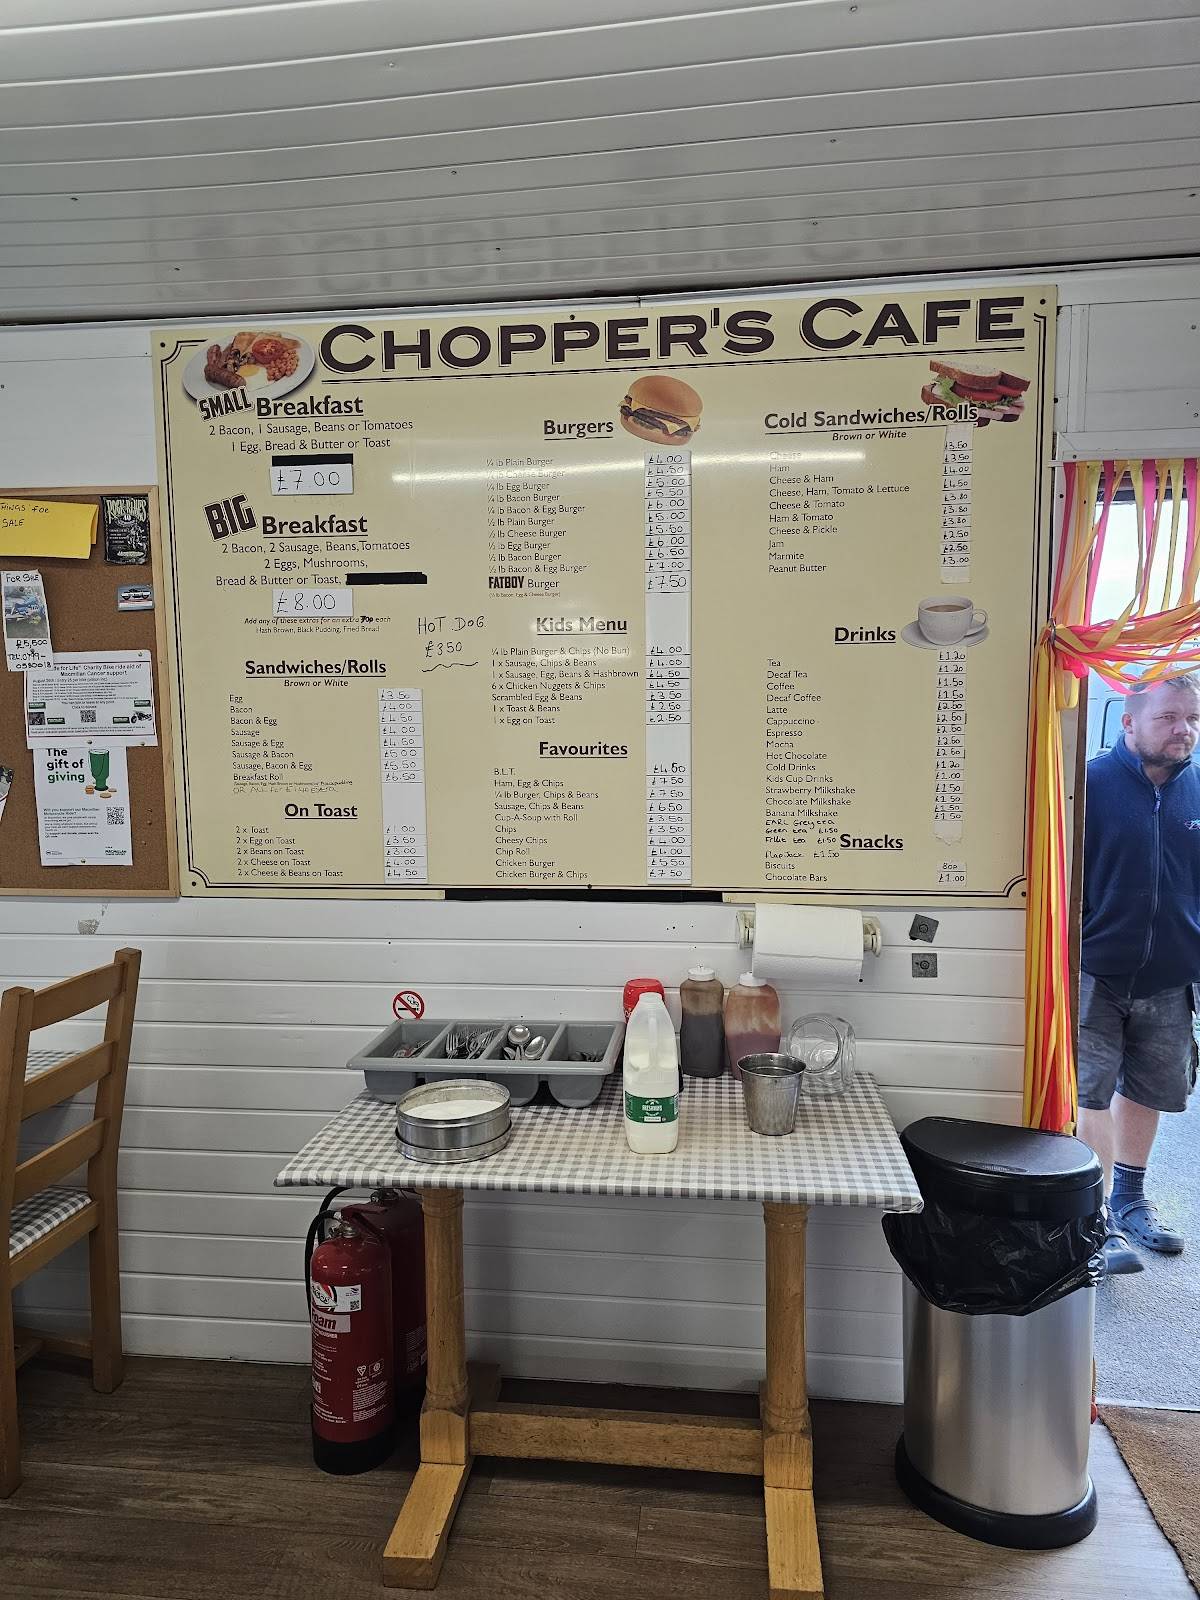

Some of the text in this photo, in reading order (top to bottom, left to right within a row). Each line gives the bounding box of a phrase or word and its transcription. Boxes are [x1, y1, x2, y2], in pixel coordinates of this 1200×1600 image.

[319, 296, 1024, 374] CHOPPER'S CAFE
[200, 388, 364, 420] SMALL Breakfast
[764, 404, 978, 430] Cold Sandwiches/Rolls
[209, 419, 413, 436] 2 Bacon, 1 Sausage, Beans or Tomatoes
[544, 420, 614, 438] Burgers
[832, 430, 907, 442] Brown or White
[232, 436, 390, 455] 1 Egg, Bread & Butter or Toast
[769, 463, 790, 472] Ham
[769, 474, 834, 484] Cheese & Ham
[204, 494, 368, 540] BIG Breakfast
[2, 518, 24, 528] SALE
[506, 517, 526, 526] Plain
[527, 517, 555, 528] Burger
[768, 525, 838, 535] Cheese & Pickle
[221, 540, 322, 555] 2 Bacon, 2 Sausage,
[767, 538, 784, 550] Jam
[768, 551, 804, 560] Marmite
[263, 556, 368, 572] 2 Eggs, Mushrooms,
[768, 563, 827, 572] Peanut Butter
[216, 573, 342, 586] Bread & Butter or Toast,
[488, 575, 560, 590] FATBOY Burger
[276, 590, 336, 612] £8.00
[536, 616, 627, 632] Kids Menu
[834, 626, 896, 642] Drinks
[245, 659, 386, 675] Sandwiches/Rolls
[766, 658, 781, 666] Tea
[767, 670, 808, 679] Decaf Tea
[283, 679, 310, 687] Brown
[323, 678, 348, 687] White
[766, 682, 795, 690] Coffee
[229, 694, 243, 704] Egg
[491, 692, 582, 703] Scrambled Egg & Beans
[766, 693, 822, 702] Decaf Coffee
[230, 705, 252, 714] Bacon
[766, 705, 788, 714] Latte
[230, 716, 278, 726] Bacon & Egg
[766, 716, 816, 727] Cappuccino
[230, 728, 260, 738] Sausage
[766, 728, 803, 739] Espresso
[231, 738, 284, 748] Sausage & Egg
[46, 748, 68, 756] The
[539, 741, 628, 756] Favourites
[231, 750, 294, 760] Sausage & Bacon
[766, 751, 827, 760] Hot Chocolate
[47, 758, 84, 770] gift of
[232, 760, 312, 772] Sausage, Bacon & Egg
[765, 762, 816, 771] Cold Drinks
[233, 772, 268, 780] Breakfast
[494, 767, 516, 776] B.L.T.
[48, 772, 84, 783] giving
[766, 772, 834, 785] Kids Cup Drinks
[765, 785, 856, 796] Strawberry Milkshake
[765, 797, 852, 806] Chocolate Milkshake
[284, 803, 358, 816] On Toast
[765, 808, 838, 819] Banana Milkshake
[494, 824, 516, 834] Chips
[495, 836, 548, 846] Cheesy Chips
[840, 834, 904, 848] Snacks
[236, 847, 242, 855] 2
[250, 847, 272, 855] Beans
[284, 847, 304, 855] Toast
[495, 858, 555, 868] Chicken Burger
[764, 861, 796, 870] Biscuits
[765, 872, 828, 882] Chocolate Bars
